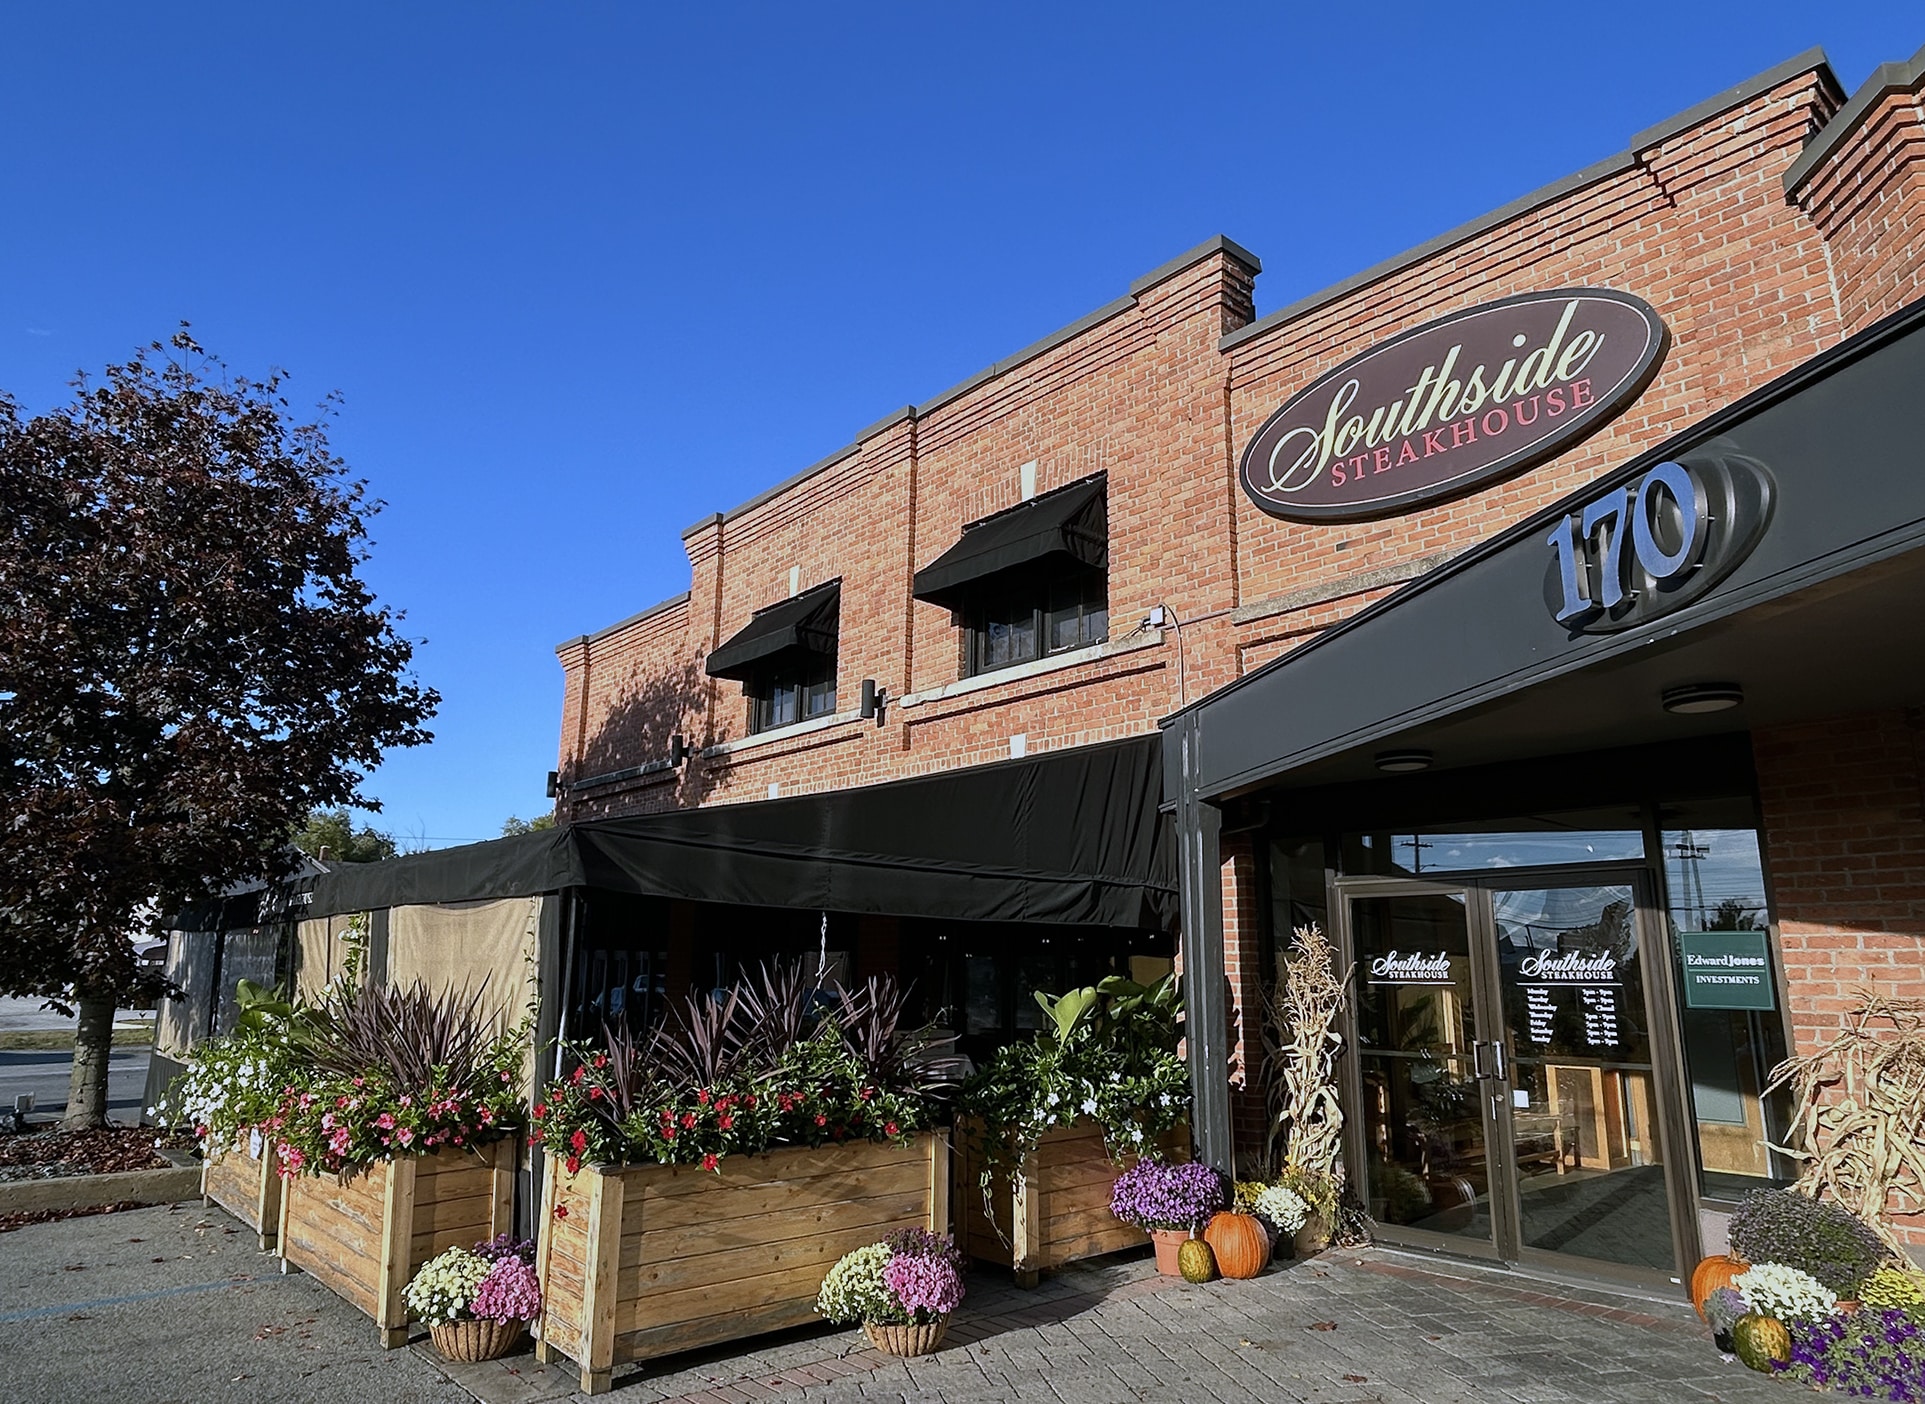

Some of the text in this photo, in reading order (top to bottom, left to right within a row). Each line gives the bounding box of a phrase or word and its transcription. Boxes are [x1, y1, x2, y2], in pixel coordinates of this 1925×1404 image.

[1261, 299, 1605, 492] Southside
[1330, 377, 1596, 488] STEAKHOUSE
[1545, 460, 1695, 622] 170
[1370, 950, 1451, 976] Southside
[1389, 971, 1449, 979] STEAKHOUSE
[1519, 949, 1616, 976] Southside
[1541, 971, 1614, 979] STEAKHOUSE
[1695, 975, 1760, 984] INVESTMENTS
